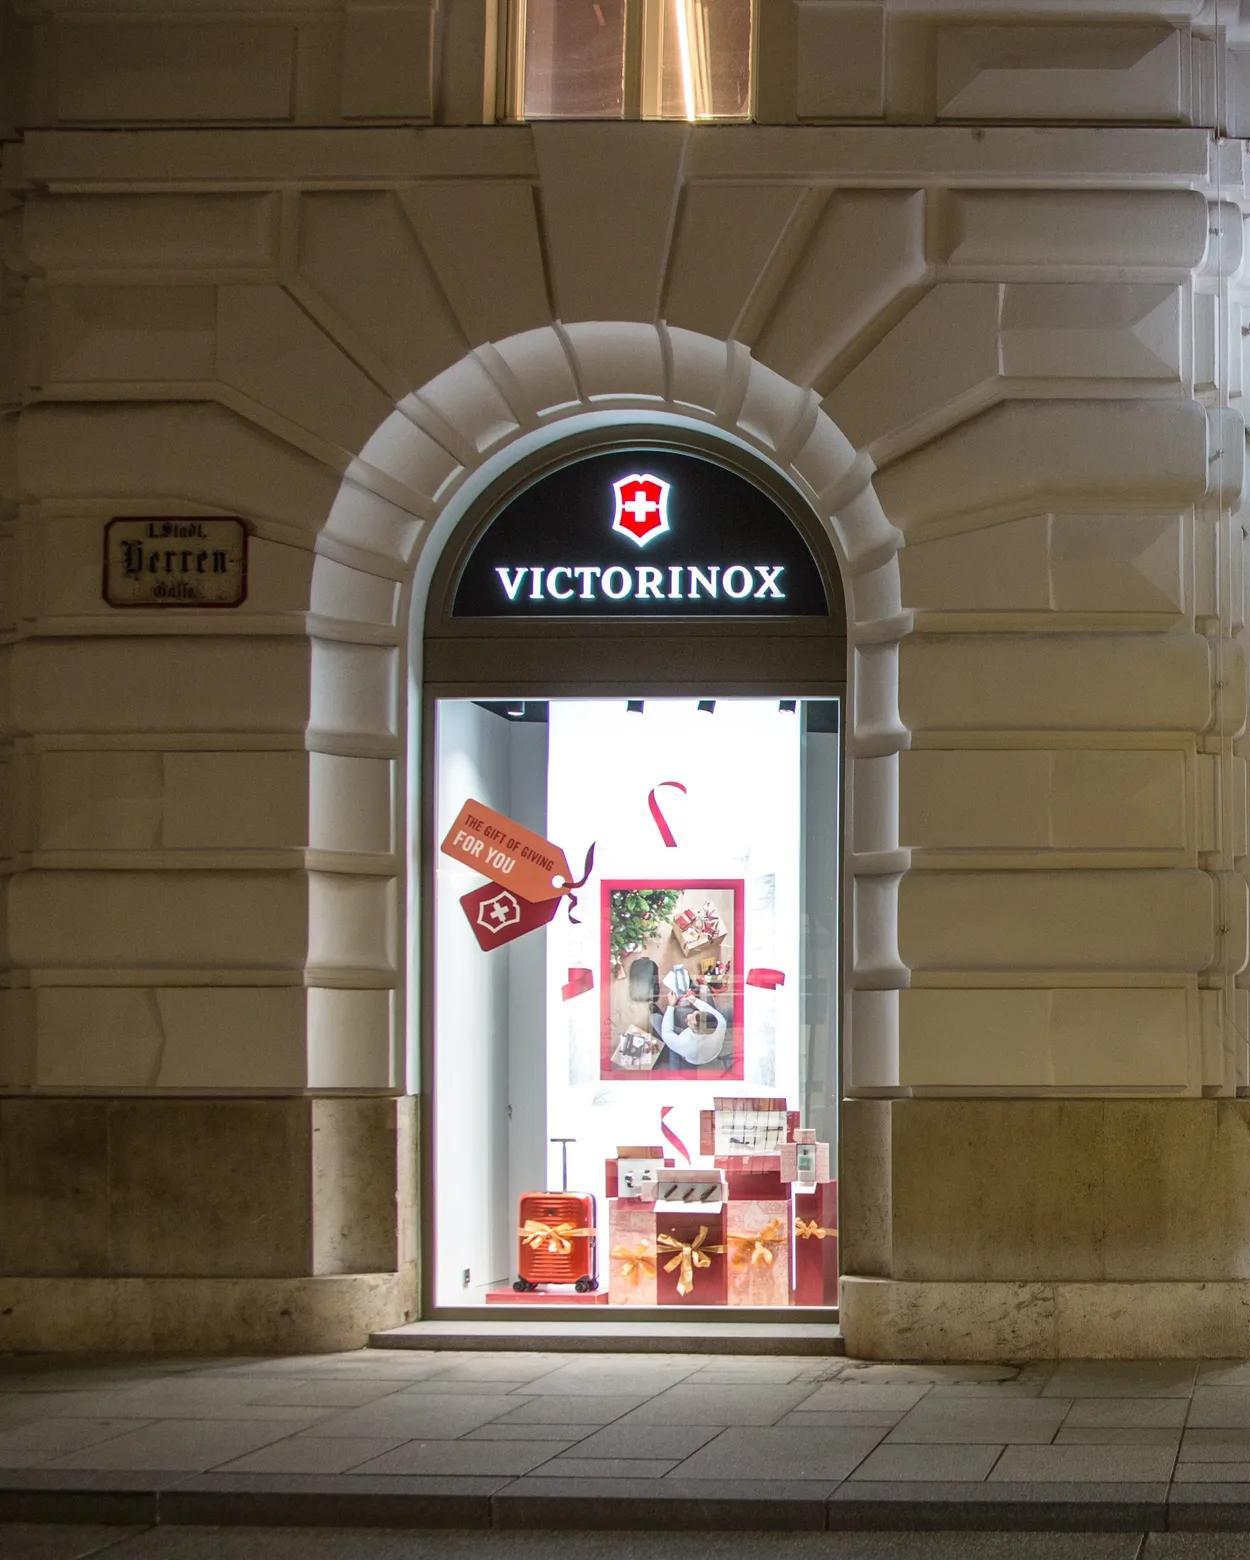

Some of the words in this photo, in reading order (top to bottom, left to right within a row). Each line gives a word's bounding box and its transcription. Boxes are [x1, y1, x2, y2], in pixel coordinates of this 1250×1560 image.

[495, 565, 786, 601] VICTORINOX
[453, 829, 485, 858] FOR
[485, 847, 516, 875] YOU
[464, 814, 485, 833] THE
[484, 825, 507, 845] GIFT
[507, 837, 521, 852] OF
[520, 846, 555, 872] GIVING
